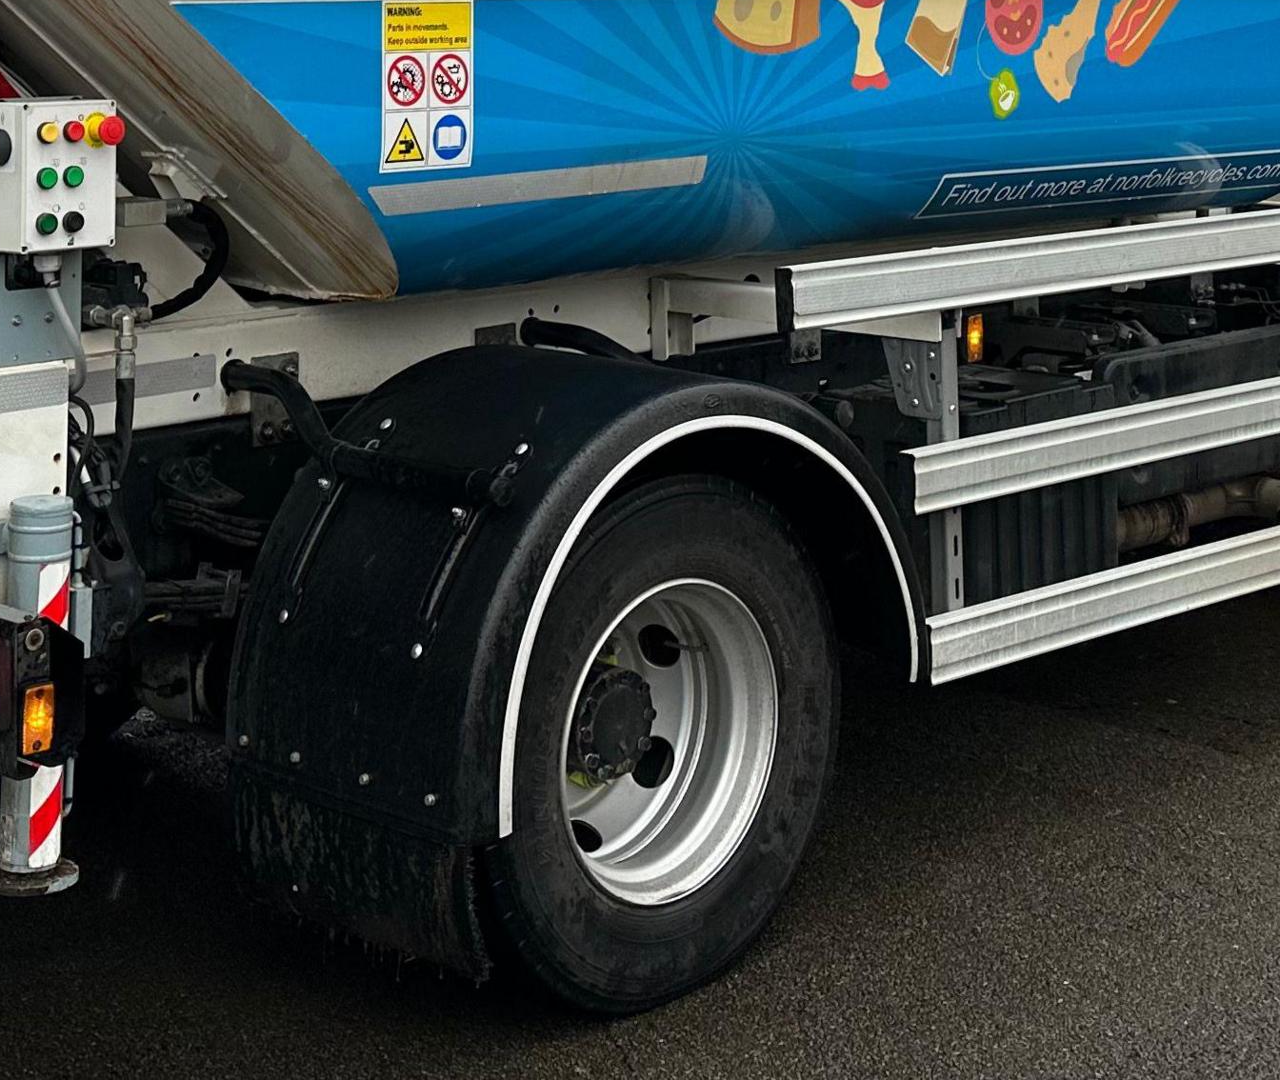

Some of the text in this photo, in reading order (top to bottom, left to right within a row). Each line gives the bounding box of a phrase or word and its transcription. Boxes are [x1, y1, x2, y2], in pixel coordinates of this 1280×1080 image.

[387, 7, 423, 17] WARNING:
[388, 23, 404, 32] Parts
[405, 23, 412, 31] in
[388, 35, 468, 47] Keep outside working area
[942, 181, 997, 207] Find
[994, 180, 1034, 202] out
[1031, 178, 1087, 199] more
[1086, 173, 1114, 195] at
